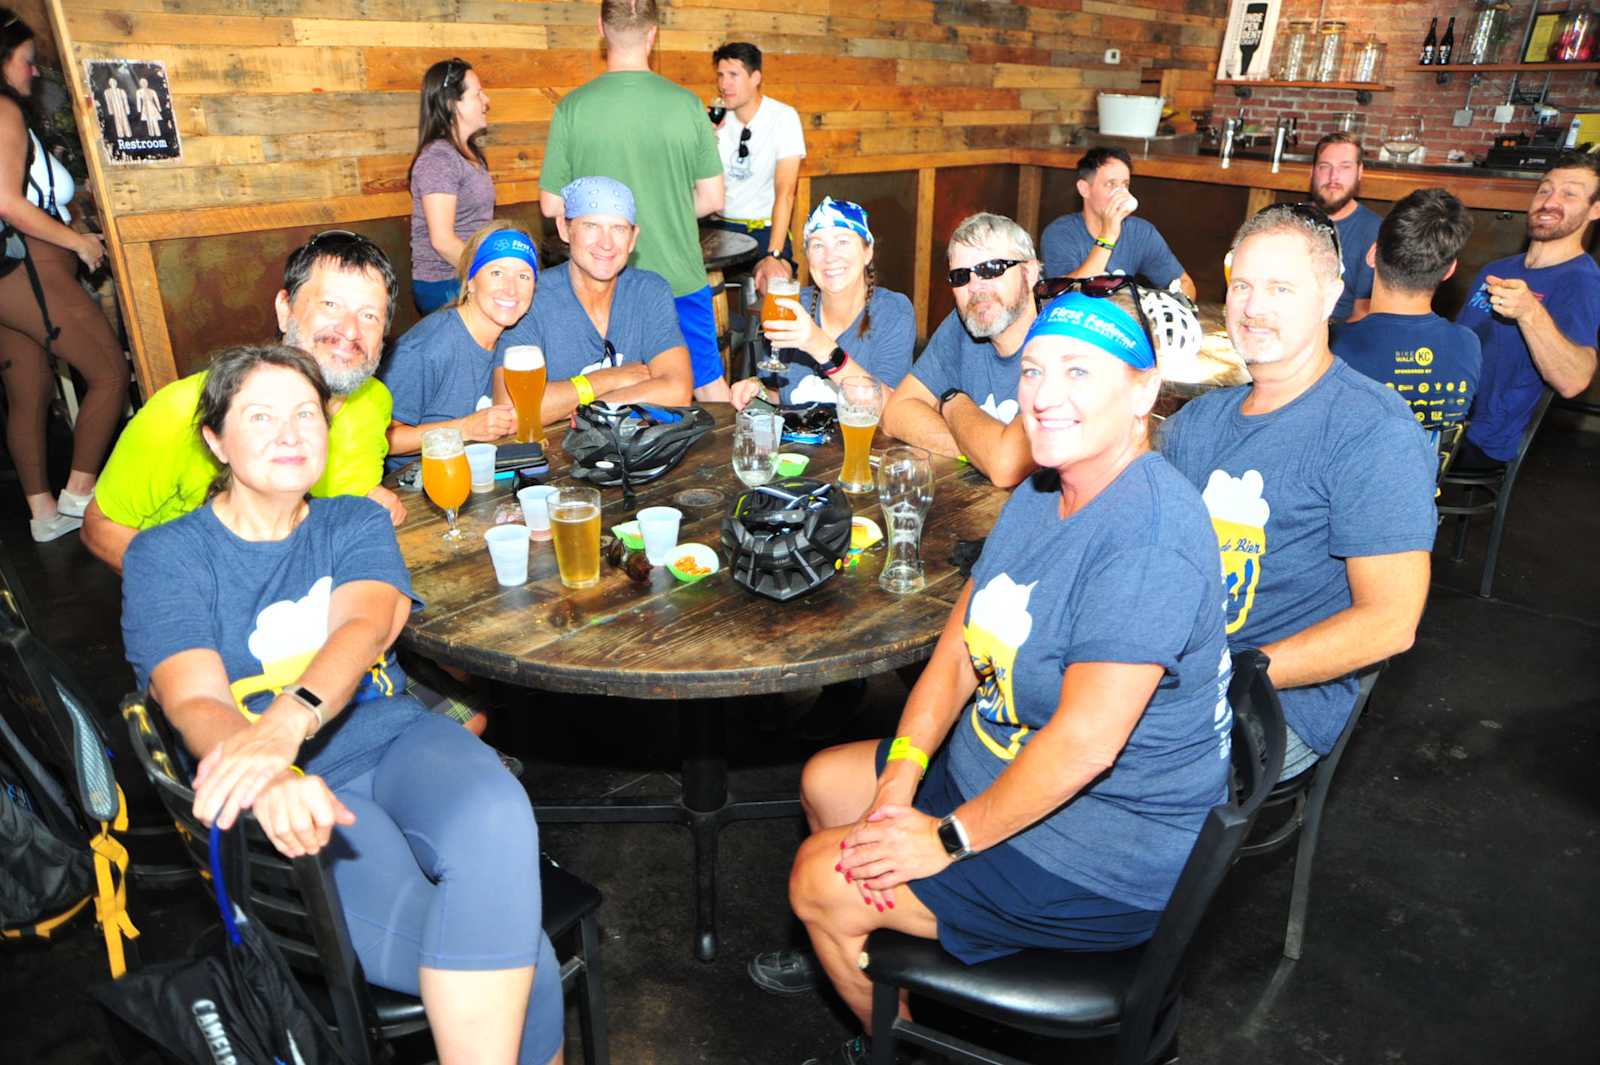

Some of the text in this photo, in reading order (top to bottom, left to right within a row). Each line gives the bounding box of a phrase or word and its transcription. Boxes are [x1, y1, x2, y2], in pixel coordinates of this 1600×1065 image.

[117, 138, 168, 150] Restroom
[1050, 307, 1083, 320] First
[1418, 351, 1431, 362] KC
[1234, 538, 1261, 553] Bier
